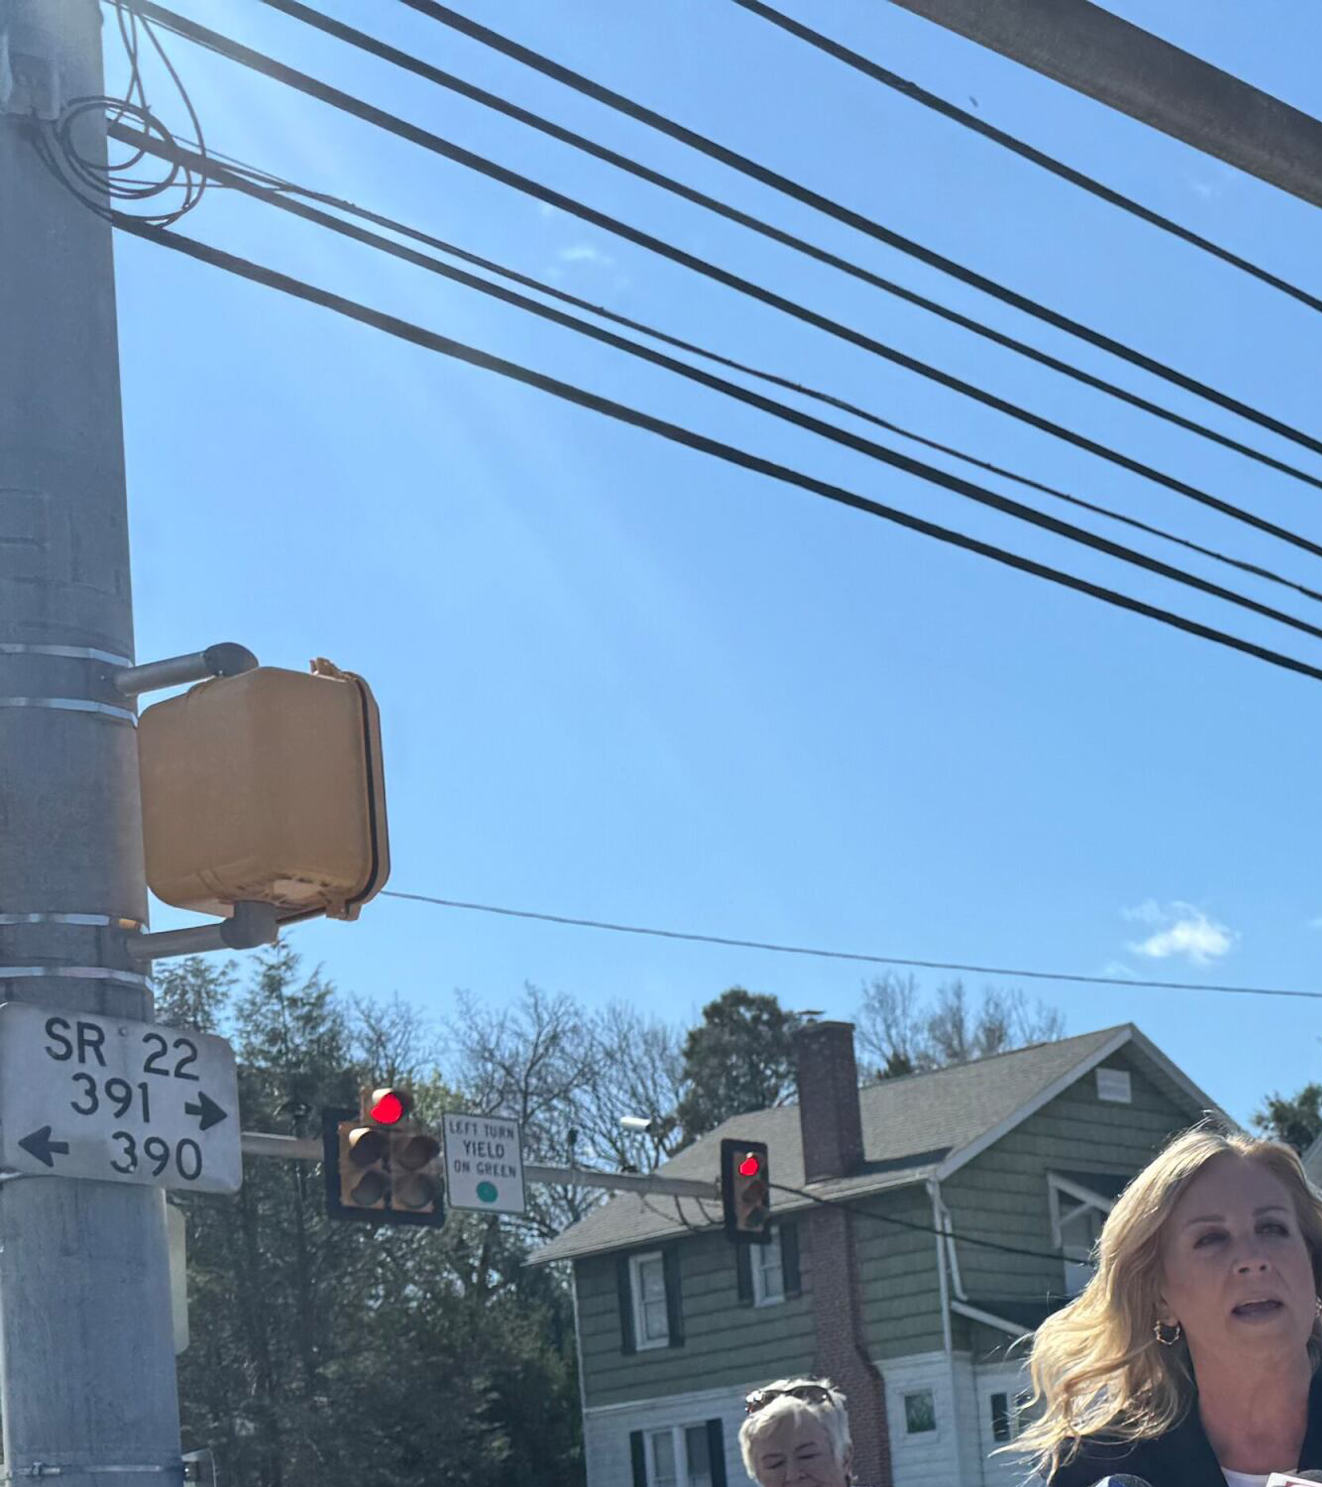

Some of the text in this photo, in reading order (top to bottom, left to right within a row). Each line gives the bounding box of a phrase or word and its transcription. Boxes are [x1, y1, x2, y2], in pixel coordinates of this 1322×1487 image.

[45, 1017, 200, 1081] SR 22
[70, 1072, 150, 1123] 391
[449, 1121, 514, 1139] LEFT TURN
[110, 1131, 203, 1181] 390
[463, 1140, 505, 1159] YIELD
[454, 1159, 516, 1178] ON GREEN
